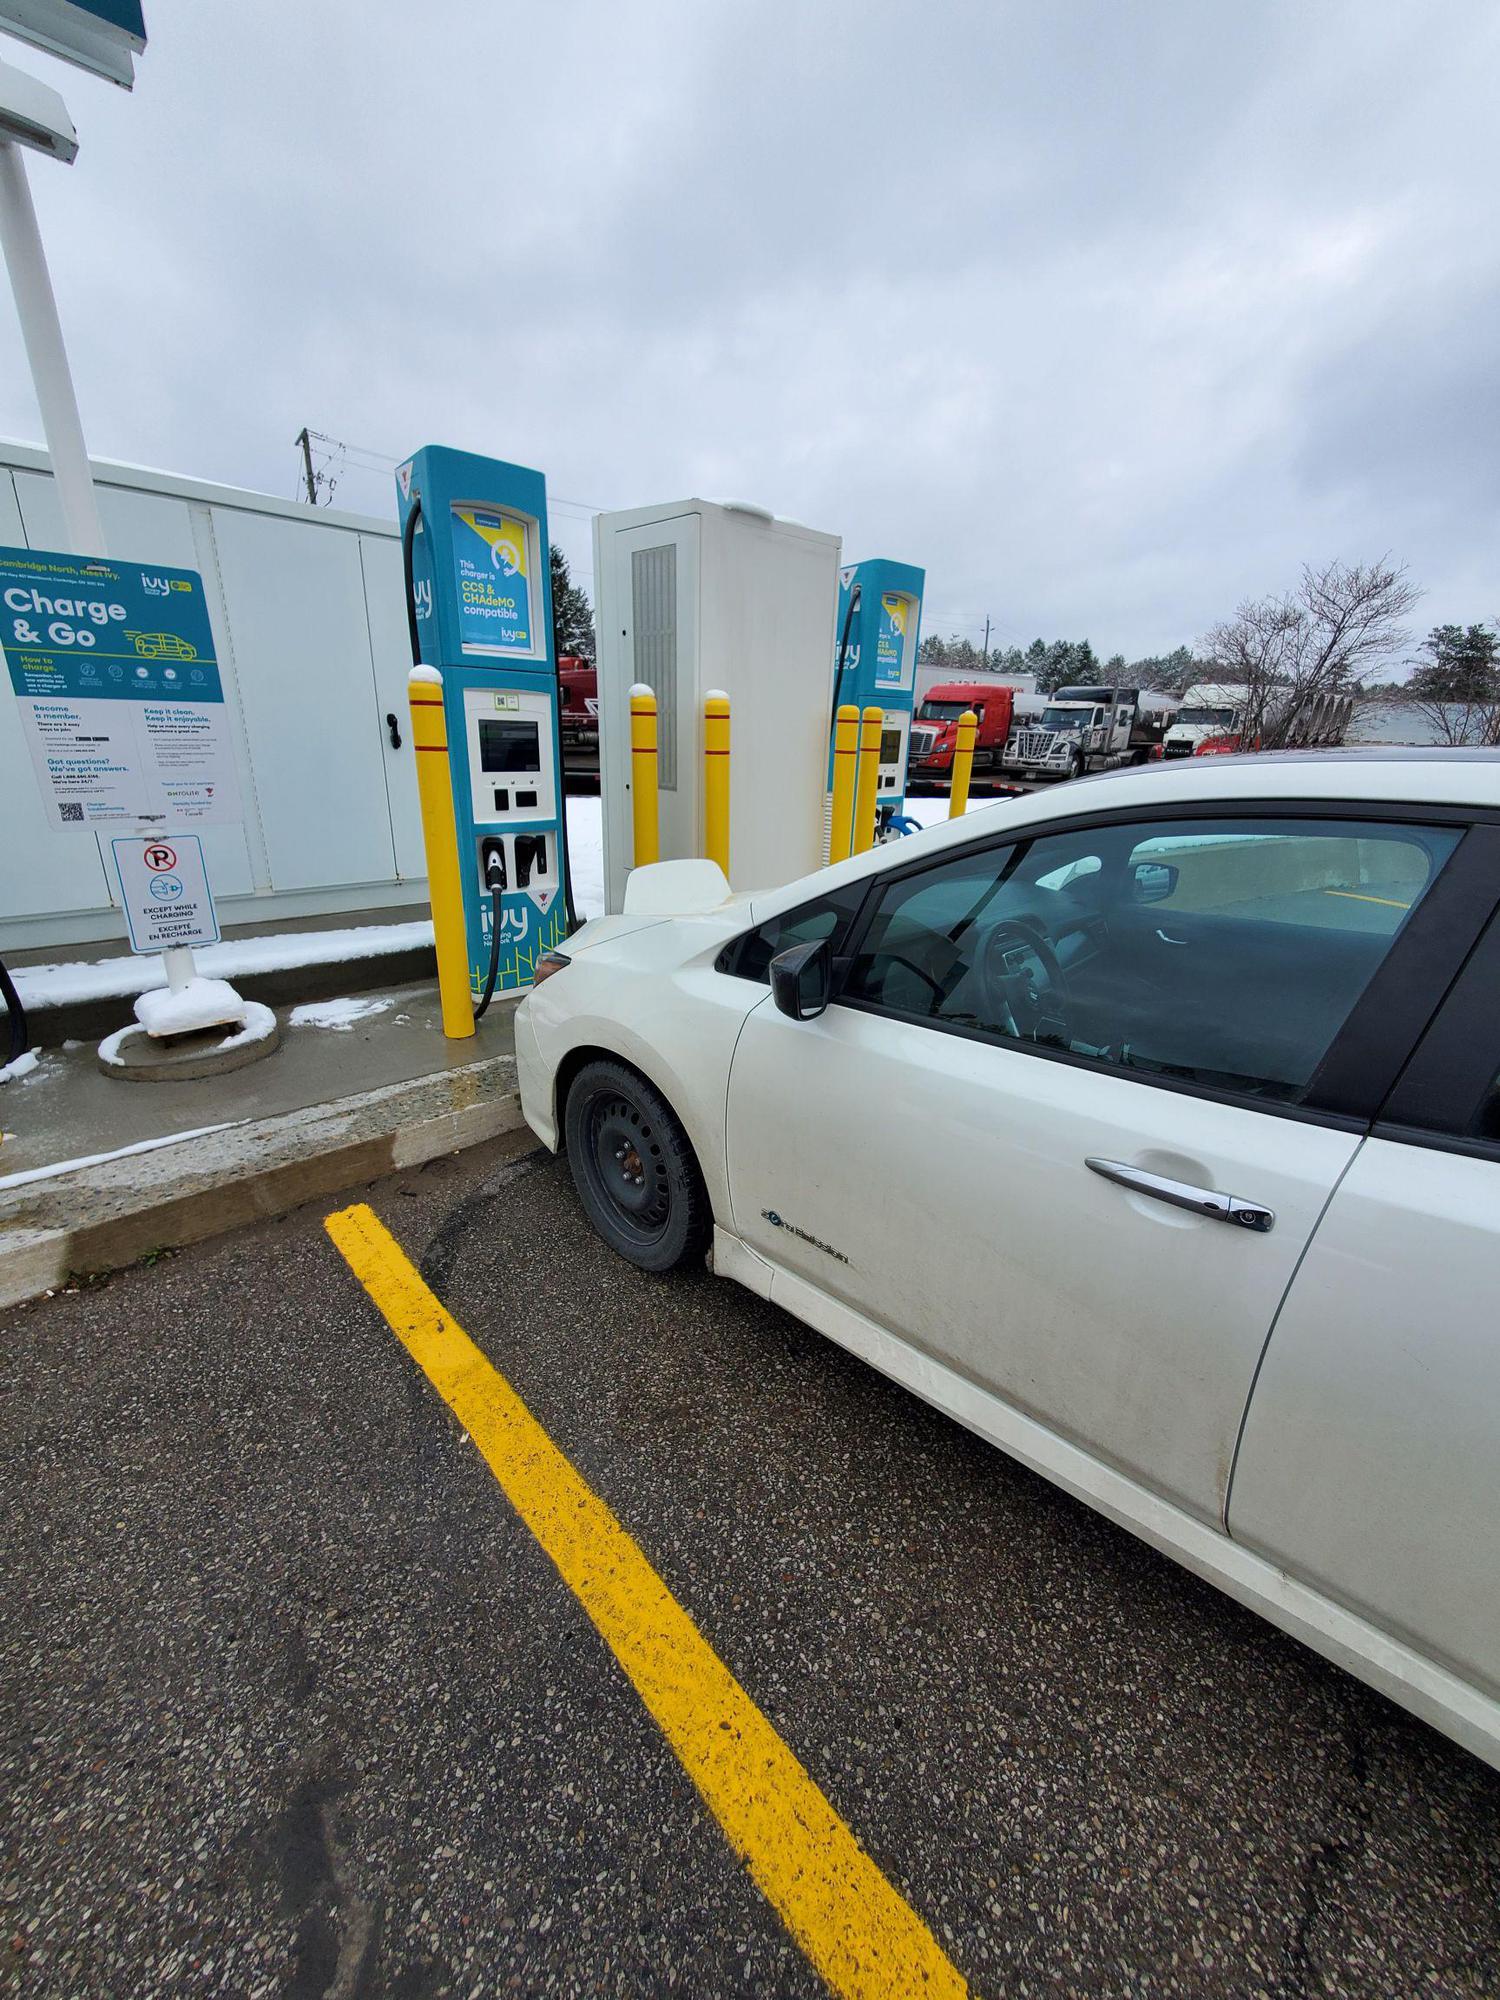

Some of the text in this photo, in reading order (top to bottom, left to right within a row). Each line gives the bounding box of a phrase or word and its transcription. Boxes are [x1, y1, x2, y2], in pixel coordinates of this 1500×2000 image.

[460, 559, 475, 569] This
[49, 564, 78, 576] North,
[460, 569, 496, 580] charger is
[141, 572, 170, 596] ivy
[462, 580, 495, 594] CCS &
[412, 579, 432, 619] vy
[463, 592, 516, 608] CHAdeMO
[4, 588, 127, 625] Charge
[463, 605, 518, 620] compatible
[13, 618, 96, 647] & Go
[501, 626, 516, 642] ivy
[21, 655, 41, 663] How
[23, 663, 57, 673] charge.
[33, 704, 69, 712] Become
[43, 712, 81, 720] member.
[145, 715, 165, 723] Keep
[174, 716, 211, 724] enjoyable.
[47, 757, 110, 766] Got questions?
[49, 765, 76, 773] We've
[77, 765, 92, 774] got
[143, 905, 172, 914] EXCEPT
[150, 910, 194, 920] CHARGING
[158, 922, 191, 933] EXCEPTÉ
[480, 904, 528, 942] ivy
[161, 929, 203, 939] RECHARGE
